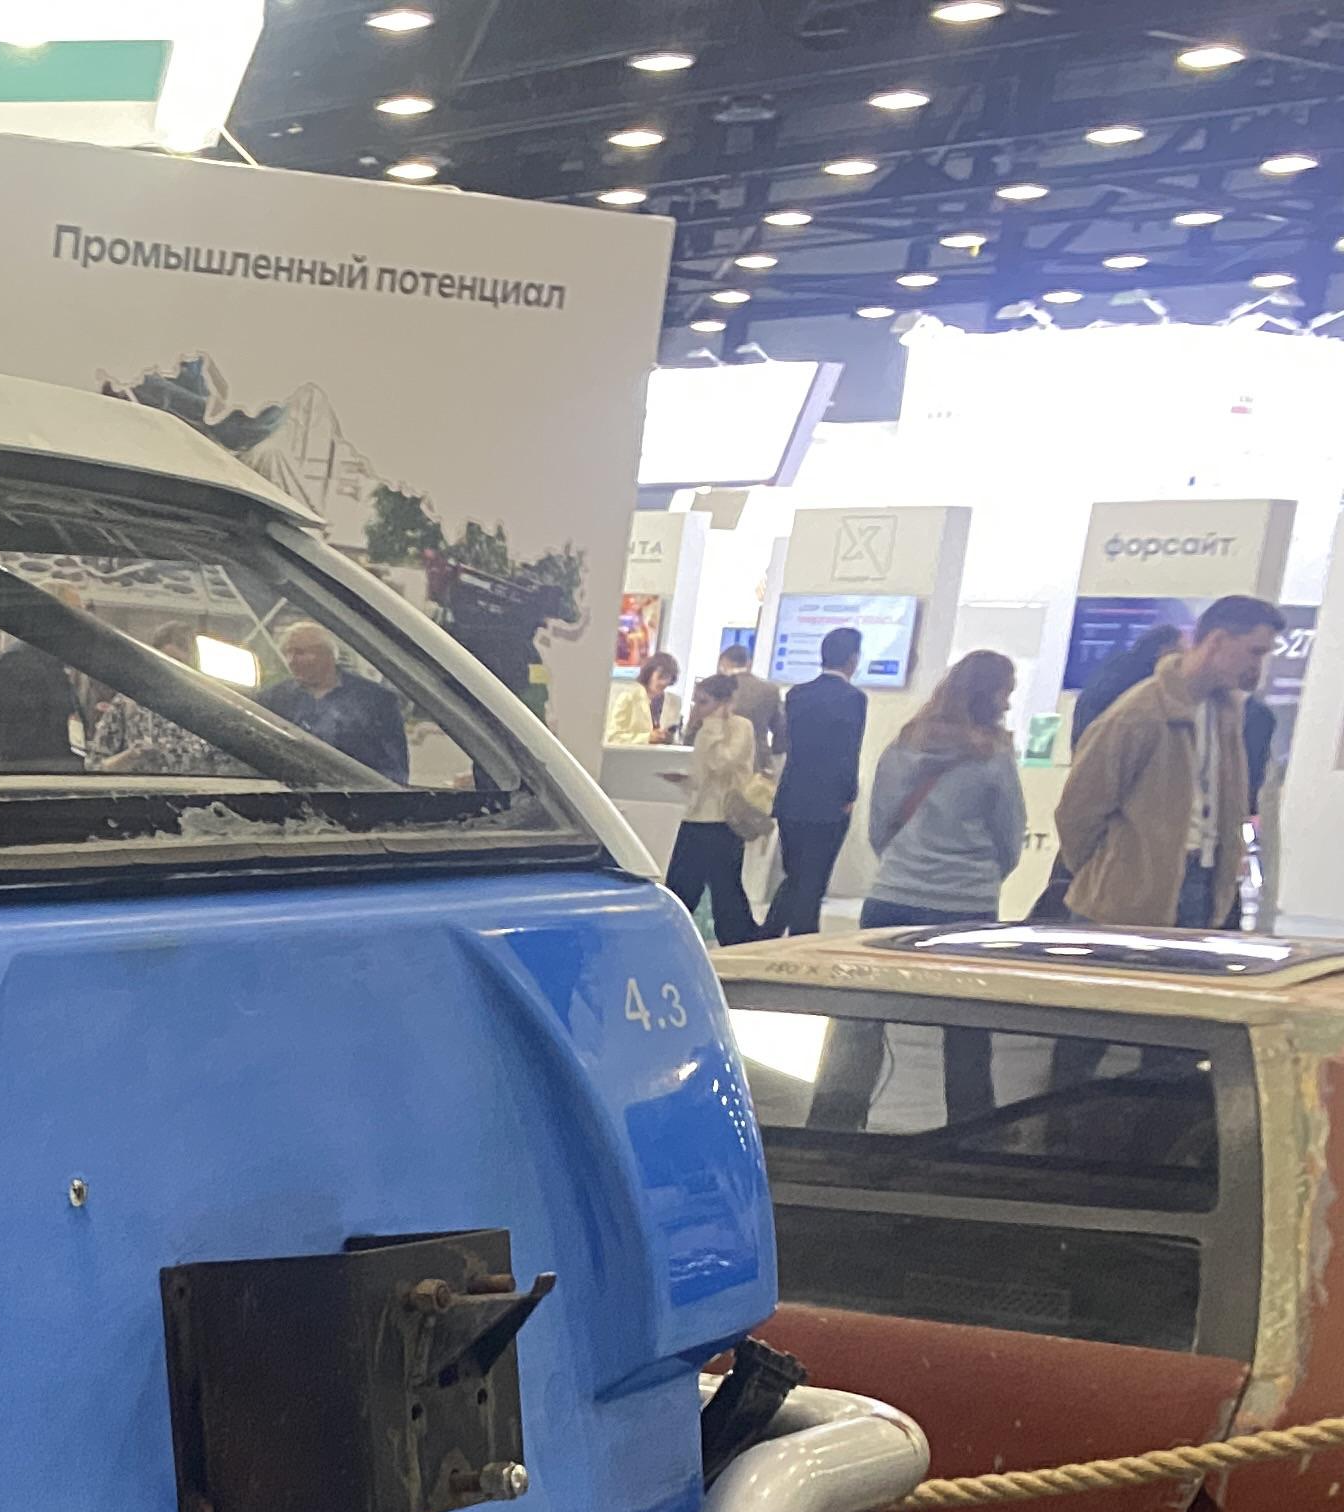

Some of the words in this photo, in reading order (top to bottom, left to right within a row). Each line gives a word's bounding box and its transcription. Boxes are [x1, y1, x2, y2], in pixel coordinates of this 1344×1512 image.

[52, 224, 369, 291] Промышленный
[375, 264, 568, 310] потенциал
[624, 977, 688, 1032] 4.3
